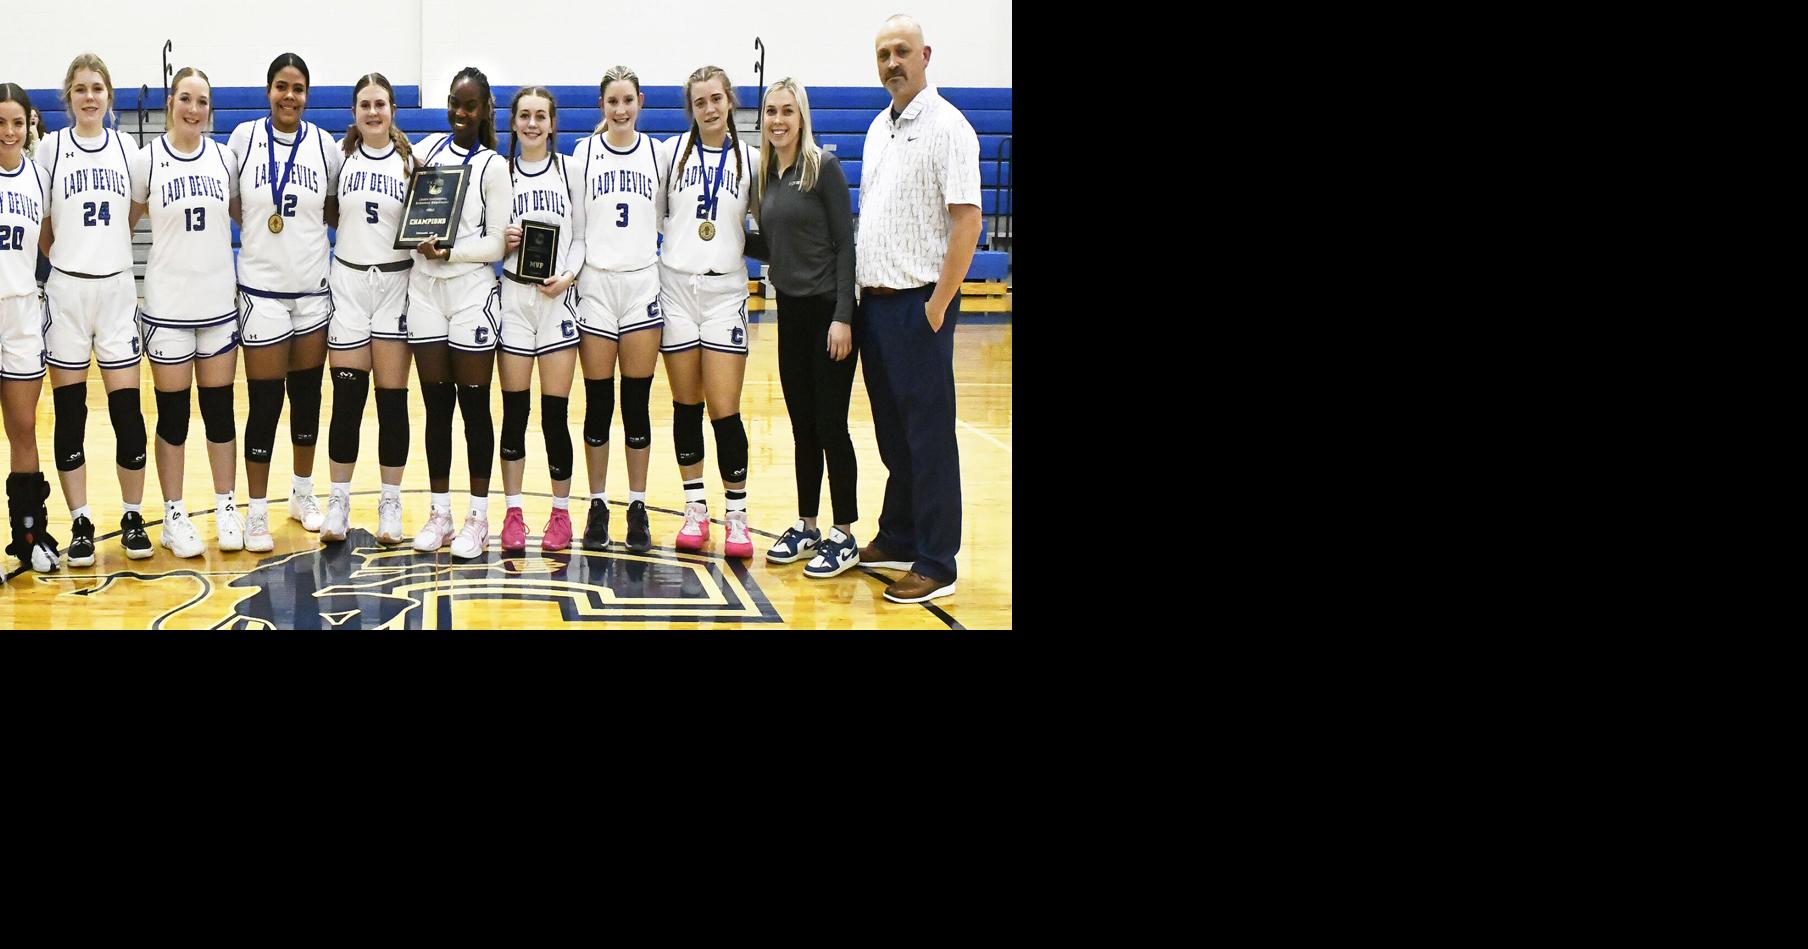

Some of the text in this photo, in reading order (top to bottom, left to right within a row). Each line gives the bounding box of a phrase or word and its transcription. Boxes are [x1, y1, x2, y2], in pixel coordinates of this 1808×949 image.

[64, 167, 126, 200] LADY DEVILS
[162, 175, 224, 208] LADY DEVILS
[342, 171, 404, 204] LADY DEVILS
[592, 169, 653, 201] LADY DEVILS
[7, 191, 39, 226] DEVILS
[83, 201, 111, 227] 24
[365, 201, 379, 224] 5
[512, 189, 565, 218] ADY DEVILS
[615, 202, 629, 228] 3
[695, 194, 719, 221] 21
[184, 207, 206, 232] 13
[409, 217, 447, 226] CHAMPIONS
[0, 224, 25, 251] 20
[529, 261, 545, 269] MVP
